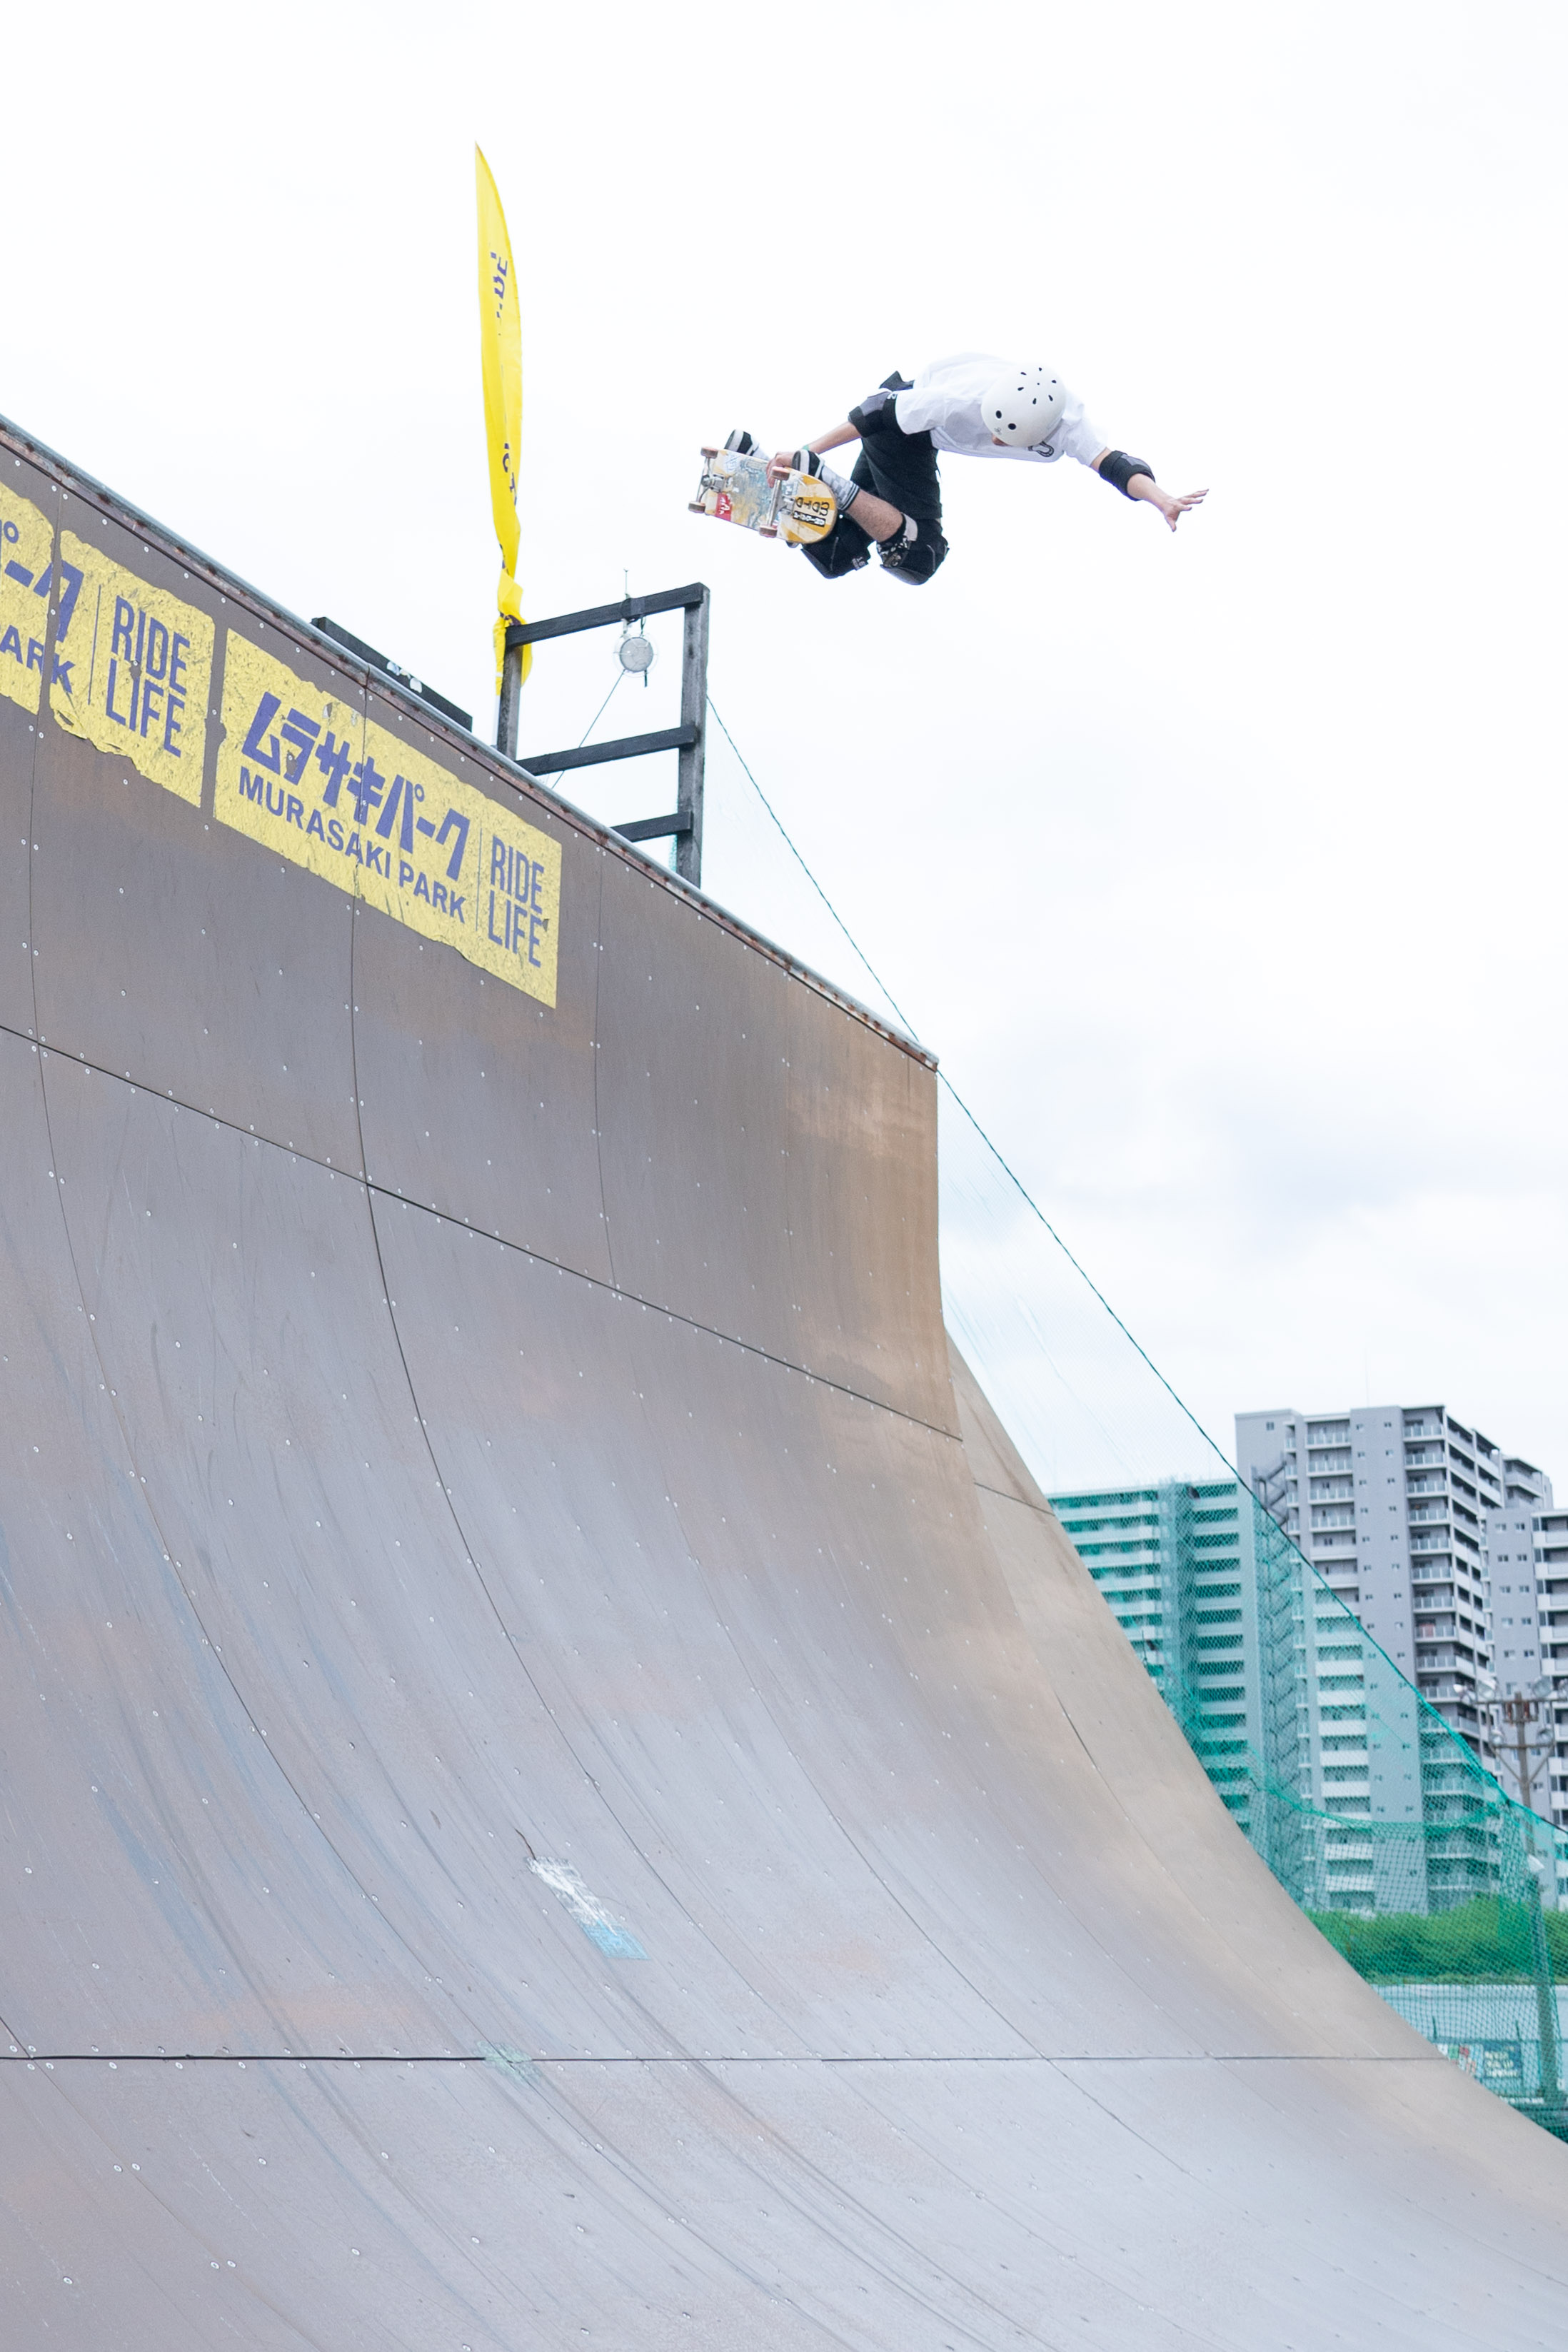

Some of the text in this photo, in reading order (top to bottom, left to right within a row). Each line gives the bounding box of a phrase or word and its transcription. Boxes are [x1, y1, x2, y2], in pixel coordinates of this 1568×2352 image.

[0, 520, 84, 643] ーク
[111, 595, 189, 695] RIDE
[106, 658, 186, 758] LIFE
[241, 691, 471, 882] ムラサキパーク
[238, 765, 466, 924] MURASAKI PARK
[491, 835, 545, 915] RIDE
[488, 890, 543, 968] LIFE
